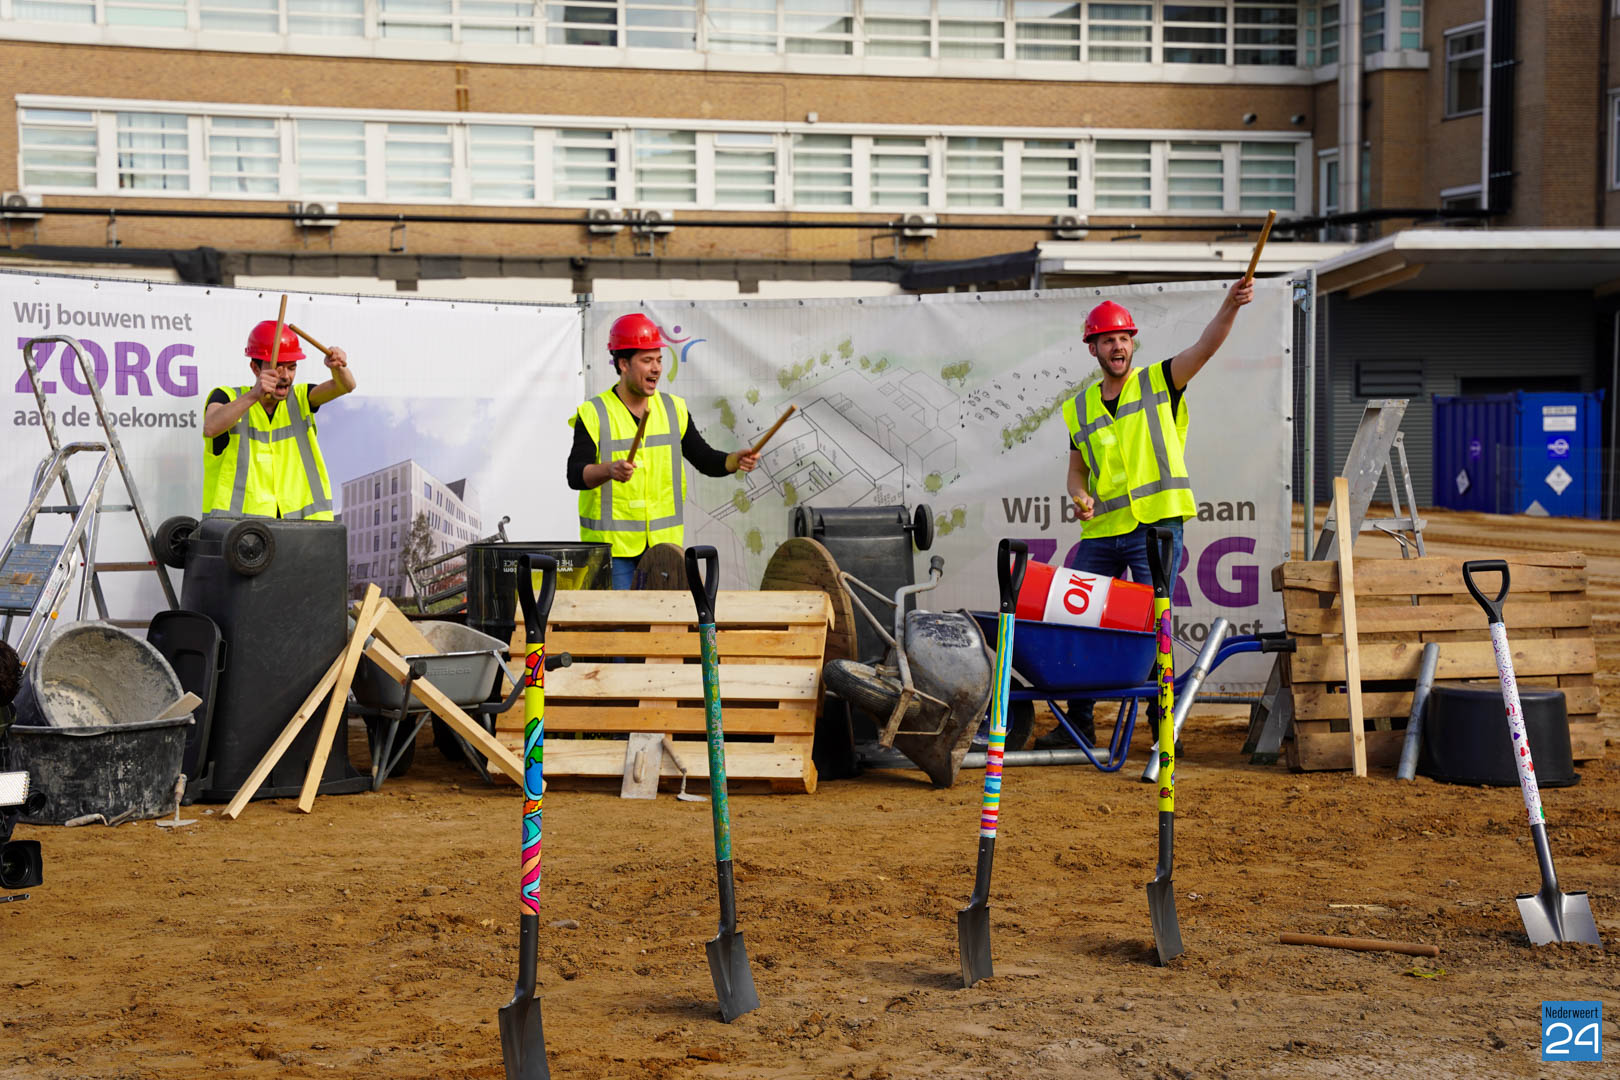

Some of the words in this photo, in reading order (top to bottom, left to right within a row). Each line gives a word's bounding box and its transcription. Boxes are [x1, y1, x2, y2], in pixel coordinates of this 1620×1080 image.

[13, 301, 50, 330] Wij
[57, 303, 145, 329] bouwen
[151, 313, 192, 331] met
[15, 336, 199, 398] ZORG
[62, 405, 90, 427] de
[1002, 497, 1051, 531] Wij
[1063, 573, 1097, 616] OK
